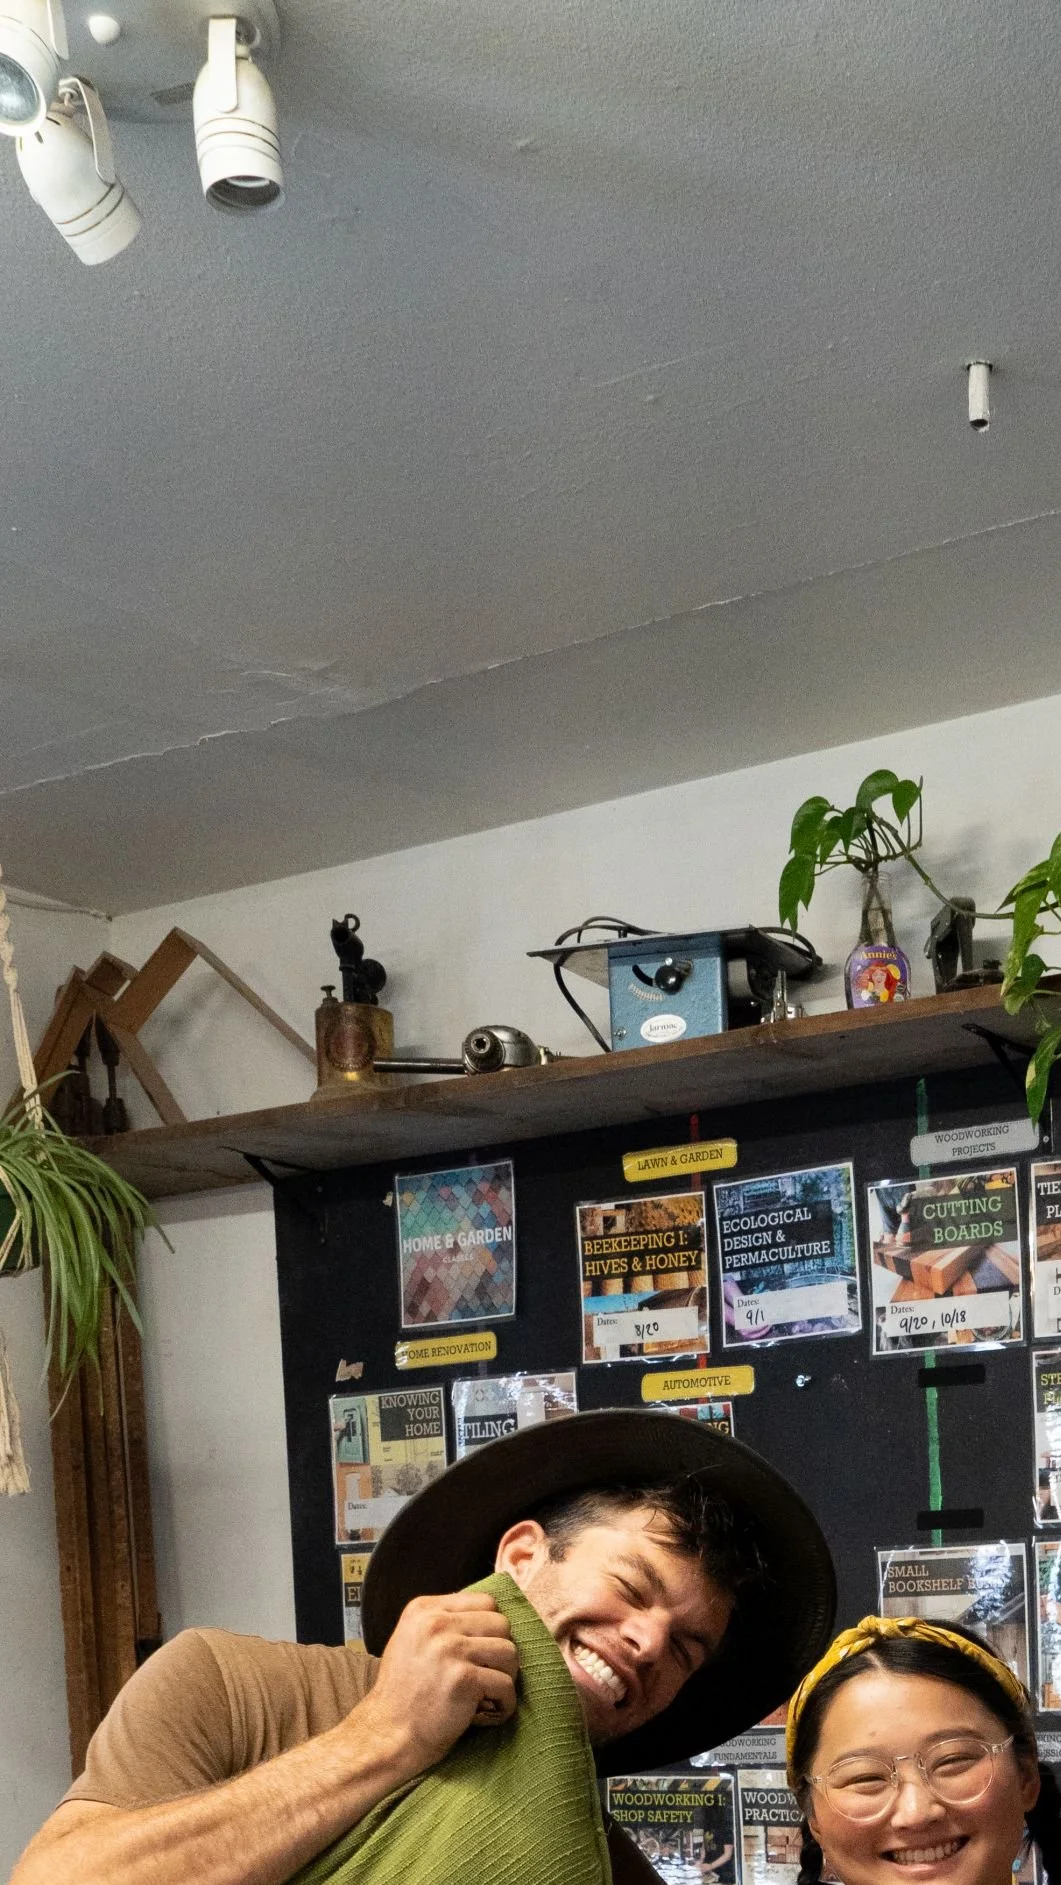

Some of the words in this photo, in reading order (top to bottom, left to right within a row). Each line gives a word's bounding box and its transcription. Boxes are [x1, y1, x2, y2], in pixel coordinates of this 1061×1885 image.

[934, 1125, 1010, 1144] WOODWORKING
[952, 1142, 996, 1157] PROJECTS
[637, 1156, 668, 1171] LAWN
[670, 1154, 678, 1165] &
[679, 1148, 723, 1165] GARDEN
[923, 1196, 1002, 1220] CUTTING
[722, 1207, 812, 1234] ECOLOGICAL
[403, 1233, 442, 1254] HOME
[446, 1232, 454, 1249] &
[457, 1226, 513, 1246] GARDEN
[934, 1220, 1004, 1244] BOARDS
[584, 1231, 675, 1256] BEEKEEPING
[679, 1232, 689, 1245] I:
[724, 1231, 772, 1252] DESIGN
[776, 1229, 786, 1243] &
[725, 1240, 831, 1269] PERMACULTURE
[585, 1257, 629, 1277] HIVES
[631, 1256, 643, 1272] &
[645, 1250, 699, 1270] HONEY
[737, 1299, 760, 1308] Dates:
[890, 1304, 915, 1315] Dates:
[597, 1317, 618, 1327] Dates:
[746, 1309, 765, 1326] 9/1
[941, 1309, 967, 1328] 10/18
[634, 1322, 660, 1340] 8/20
[431, 1341, 492, 1357] RENOVATION
[662, 1375, 732, 1391] AUTOMOTIVE
[381, 1391, 440, 1409] KNOWING
[407, 1406, 440, 1421] YOUR
[405, 1422, 441, 1437] HOME
[463, 1419, 517, 1439] TILING
[887, 1564, 929, 1578] SMALL
[888, 1579, 963, 1593] BOOKSHELF
[720, 1737, 777, 1748] ODWORKING
[714, 1751, 777, 1761] FUNDAMENTALS
[612, 1793, 715, 1806] WOODWORKING
[716, 1794, 726, 1807] I:
[743, 1792, 798, 1805] WOODW
[613, 1810, 645, 1822] SHOP
[647, 1810, 694, 1823] SAFETY
